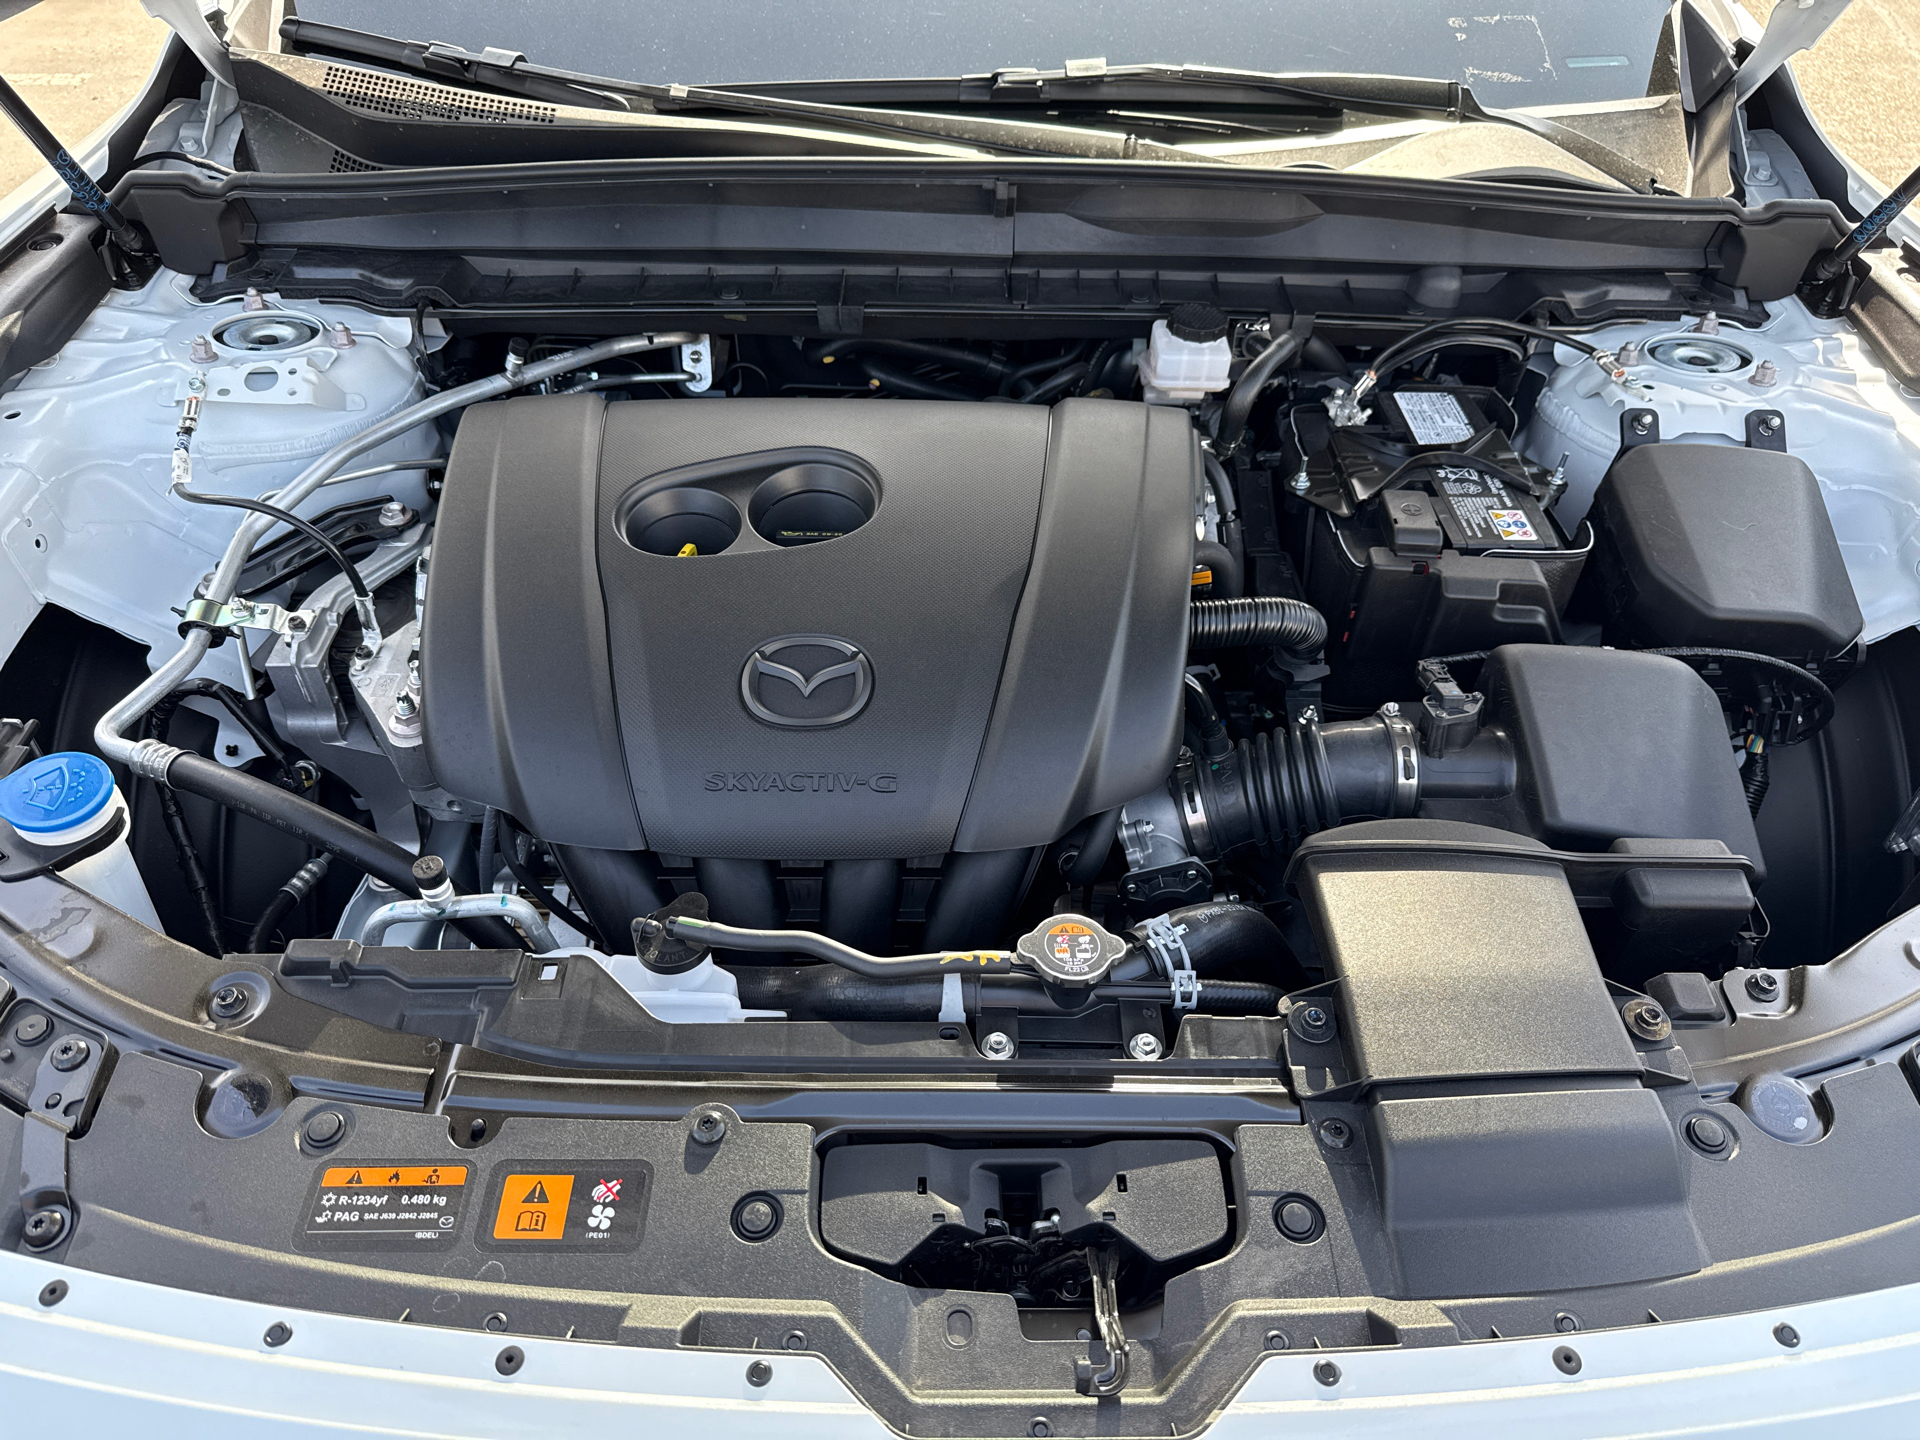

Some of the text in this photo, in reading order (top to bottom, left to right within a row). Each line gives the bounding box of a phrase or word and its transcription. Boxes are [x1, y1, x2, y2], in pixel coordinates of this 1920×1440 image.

[704, 772, 898, 793] SKYACTIV-G
[641, 943, 686, 962] COOLANT
[339, 1195, 447, 1207] R-1234yf 0.480 kg
[334, 1212, 359, 1222] PAG
